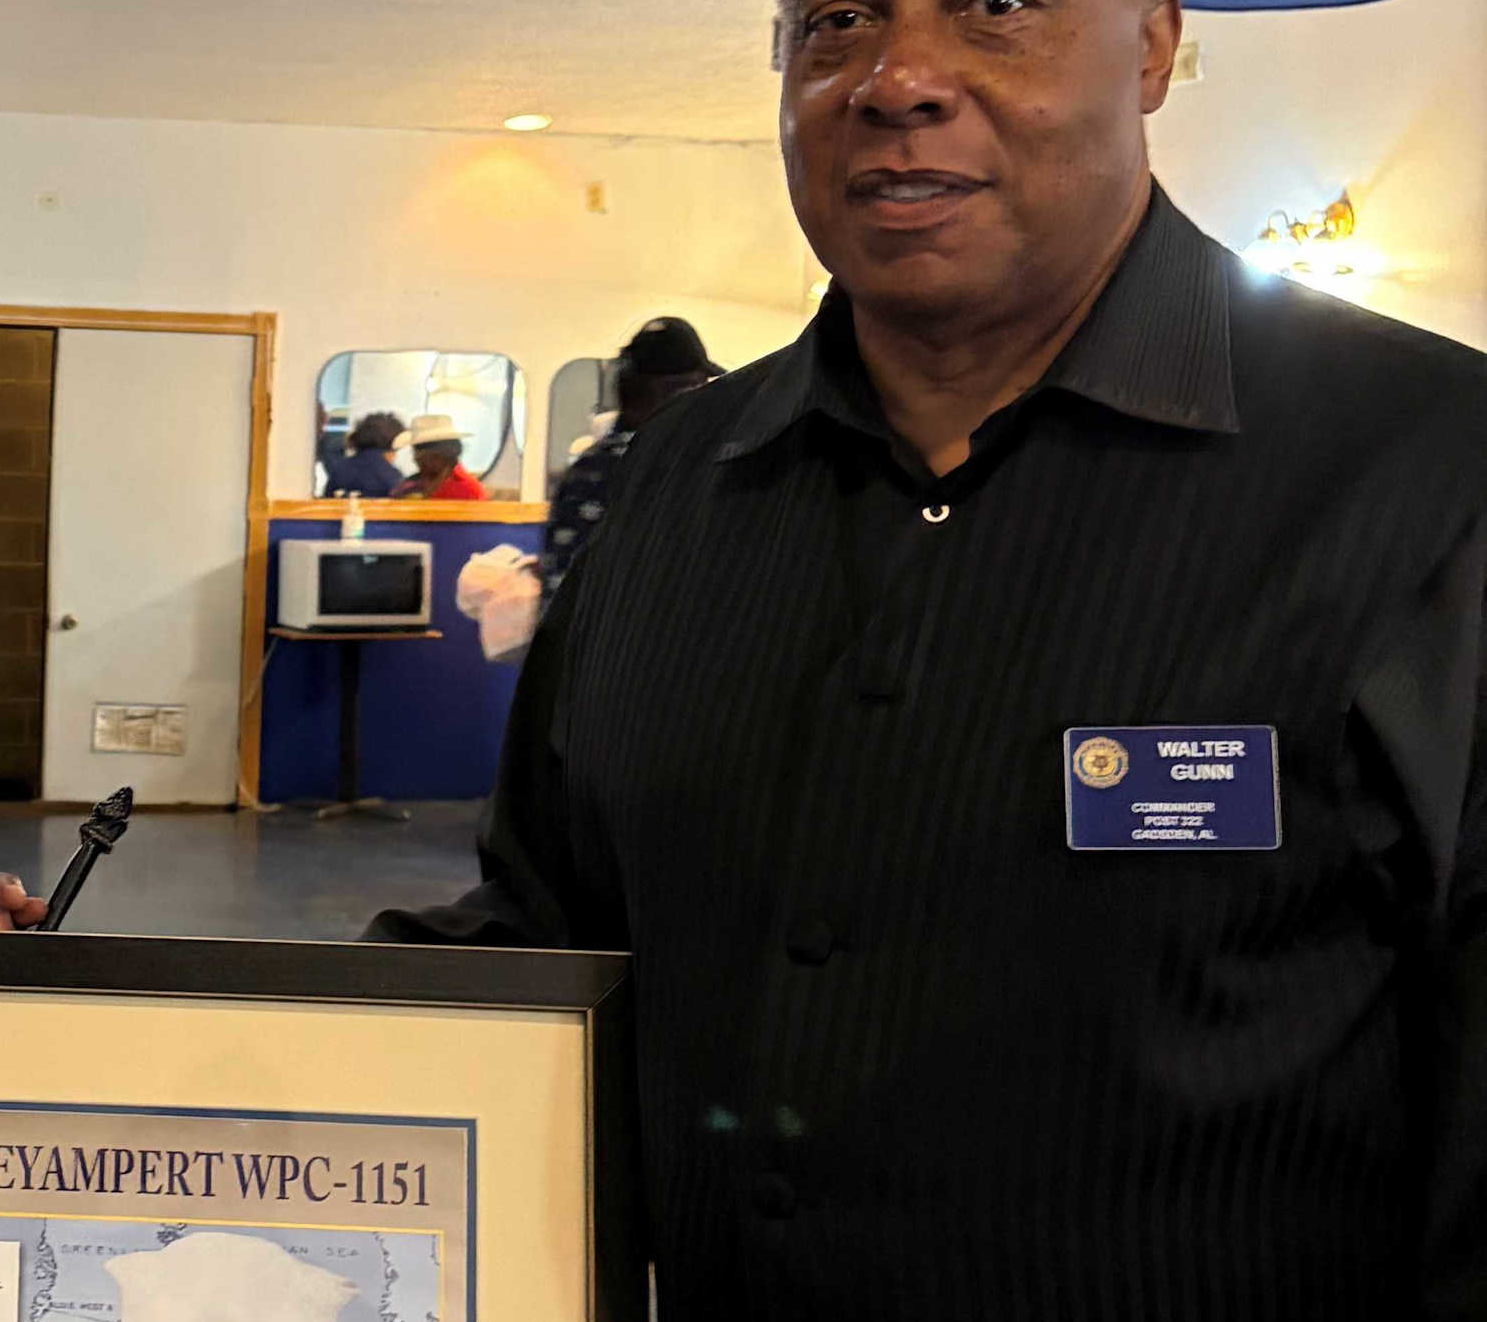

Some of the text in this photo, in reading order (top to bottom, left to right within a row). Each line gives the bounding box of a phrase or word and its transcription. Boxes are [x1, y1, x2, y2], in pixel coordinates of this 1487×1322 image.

[1156, 740, 1246, 758] WALTER
[1170, 764, 1234, 781] GUNN
[1131, 802, 1216, 813] COMMANDER
[232, 1153, 430, 1207] WPC-1151
